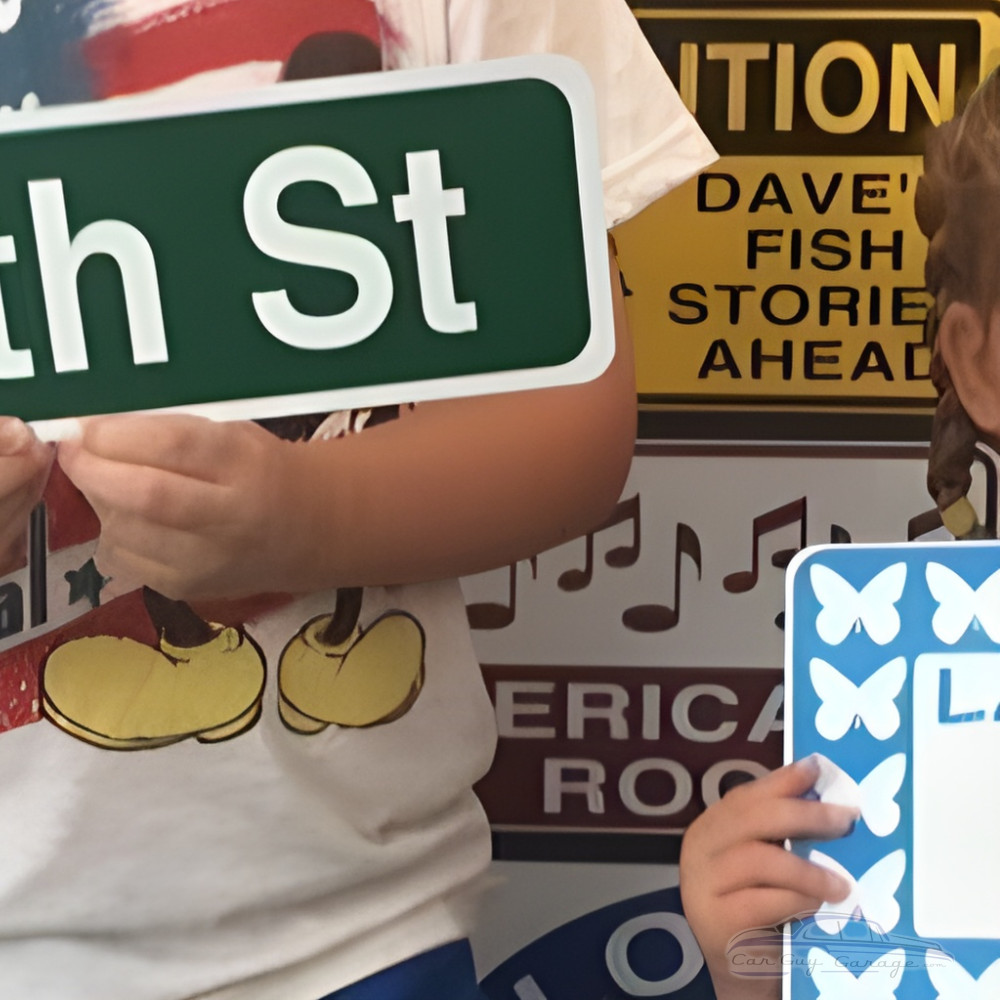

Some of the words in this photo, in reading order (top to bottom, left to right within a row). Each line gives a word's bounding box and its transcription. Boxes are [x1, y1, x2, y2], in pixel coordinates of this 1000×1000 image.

[243, 145, 478, 350] St
[747, 229, 904, 271] FISH
[938, 668, 1000, 723] L
